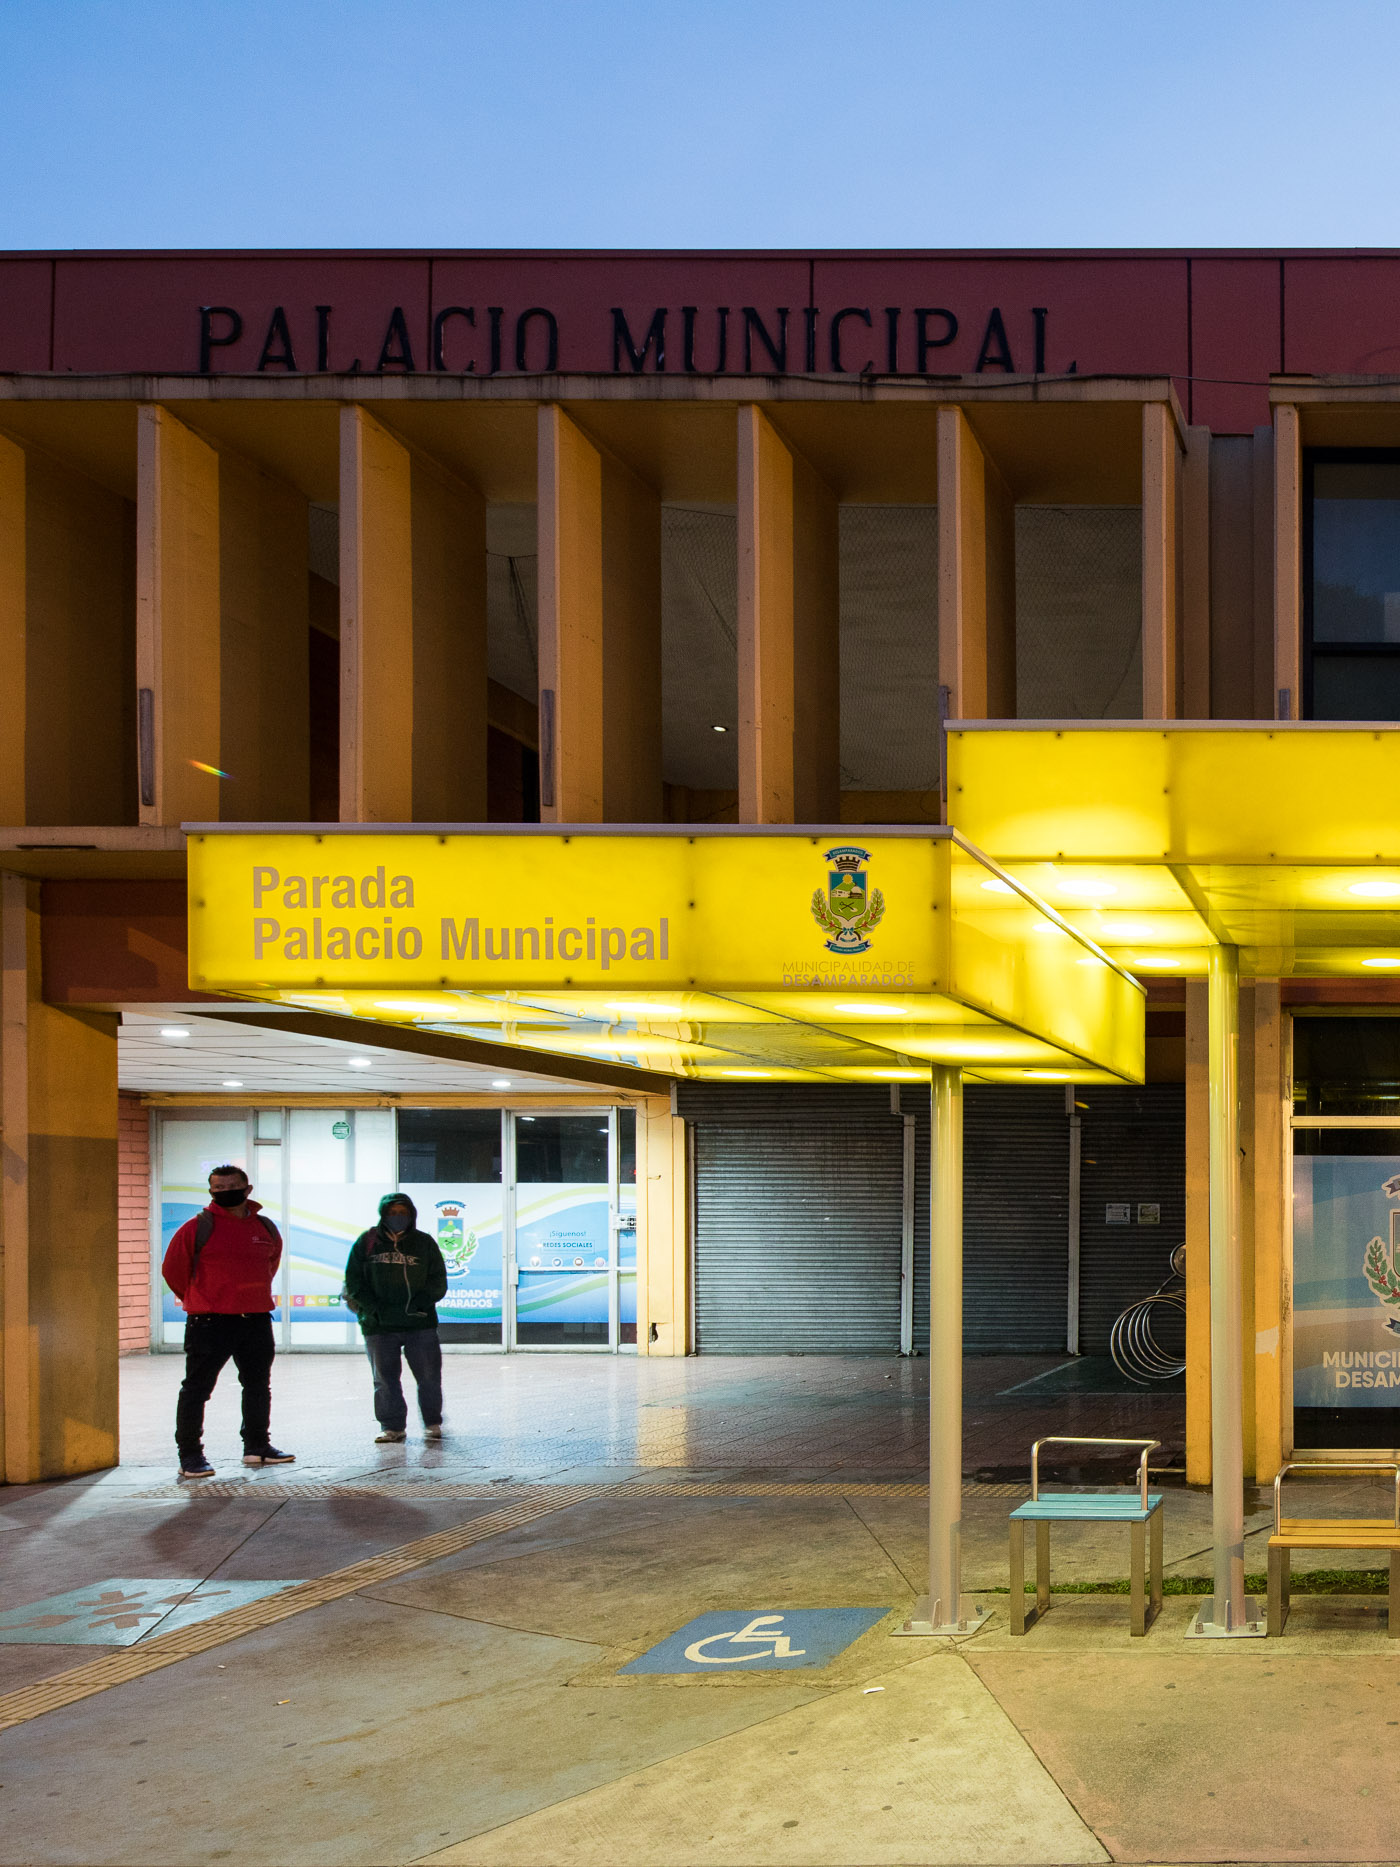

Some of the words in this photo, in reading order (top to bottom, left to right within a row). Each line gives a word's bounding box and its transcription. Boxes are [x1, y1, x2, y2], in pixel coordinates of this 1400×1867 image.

[199, 305, 560, 375] PALACIO
[609, 305, 1079, 375] MUNICIPAL
[253, 865, 415, 909] Parada
[253, 916, 423, 961] Palacio
[440, 916, 670, 971] Municipal
[782, 960, 893, 973] MUNICIPALIDAD
[897, 960, 916, 973] DE
[782, 973, 915, 987] DESAMPARADOS
[549, 1230, 587, 1239] ¡Síguenos!
[484, 1289, 499, 1298] DE
